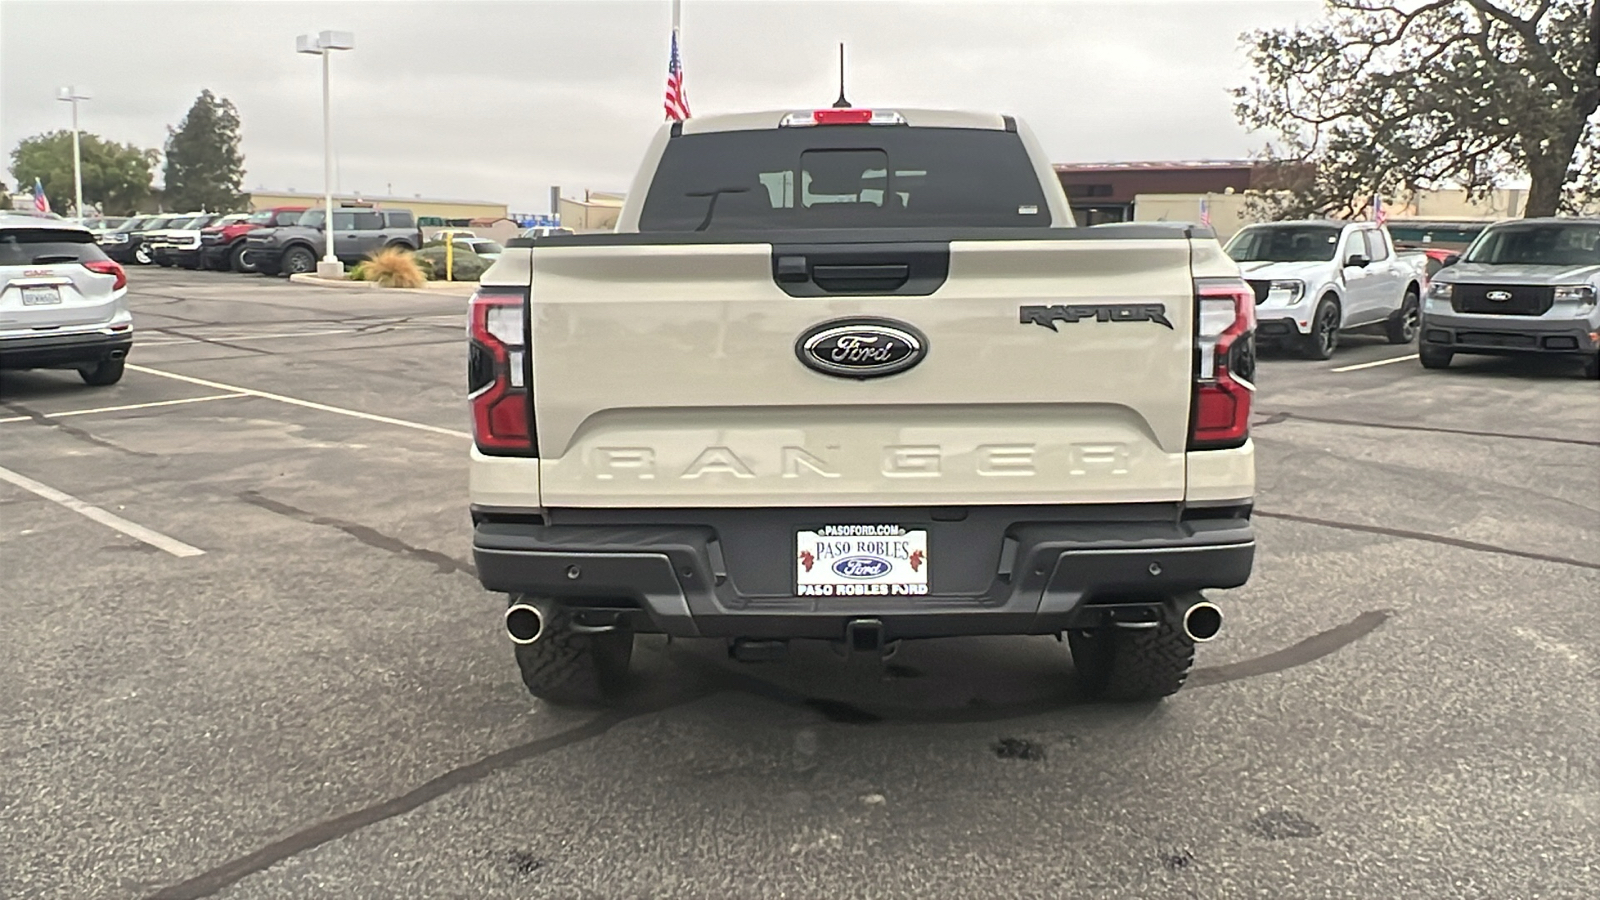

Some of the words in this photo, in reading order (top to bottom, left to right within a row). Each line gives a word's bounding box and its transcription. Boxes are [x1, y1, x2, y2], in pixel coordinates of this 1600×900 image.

[1020, 303, 1174, 333] RAPTOR
[831, 335, 893, 362] Ford
[596, 444, 1130, 480] RANGER
[825, 525, 899, 536] PASOFORD.COM
[816, 541, 850, 560] PASO
[857, 541, 909, 560] ROBLES
[844, 559, 881, 576] Ford
[797, 584, 833, 596] PASO
[836, 584, 888, 596] ROBLES
